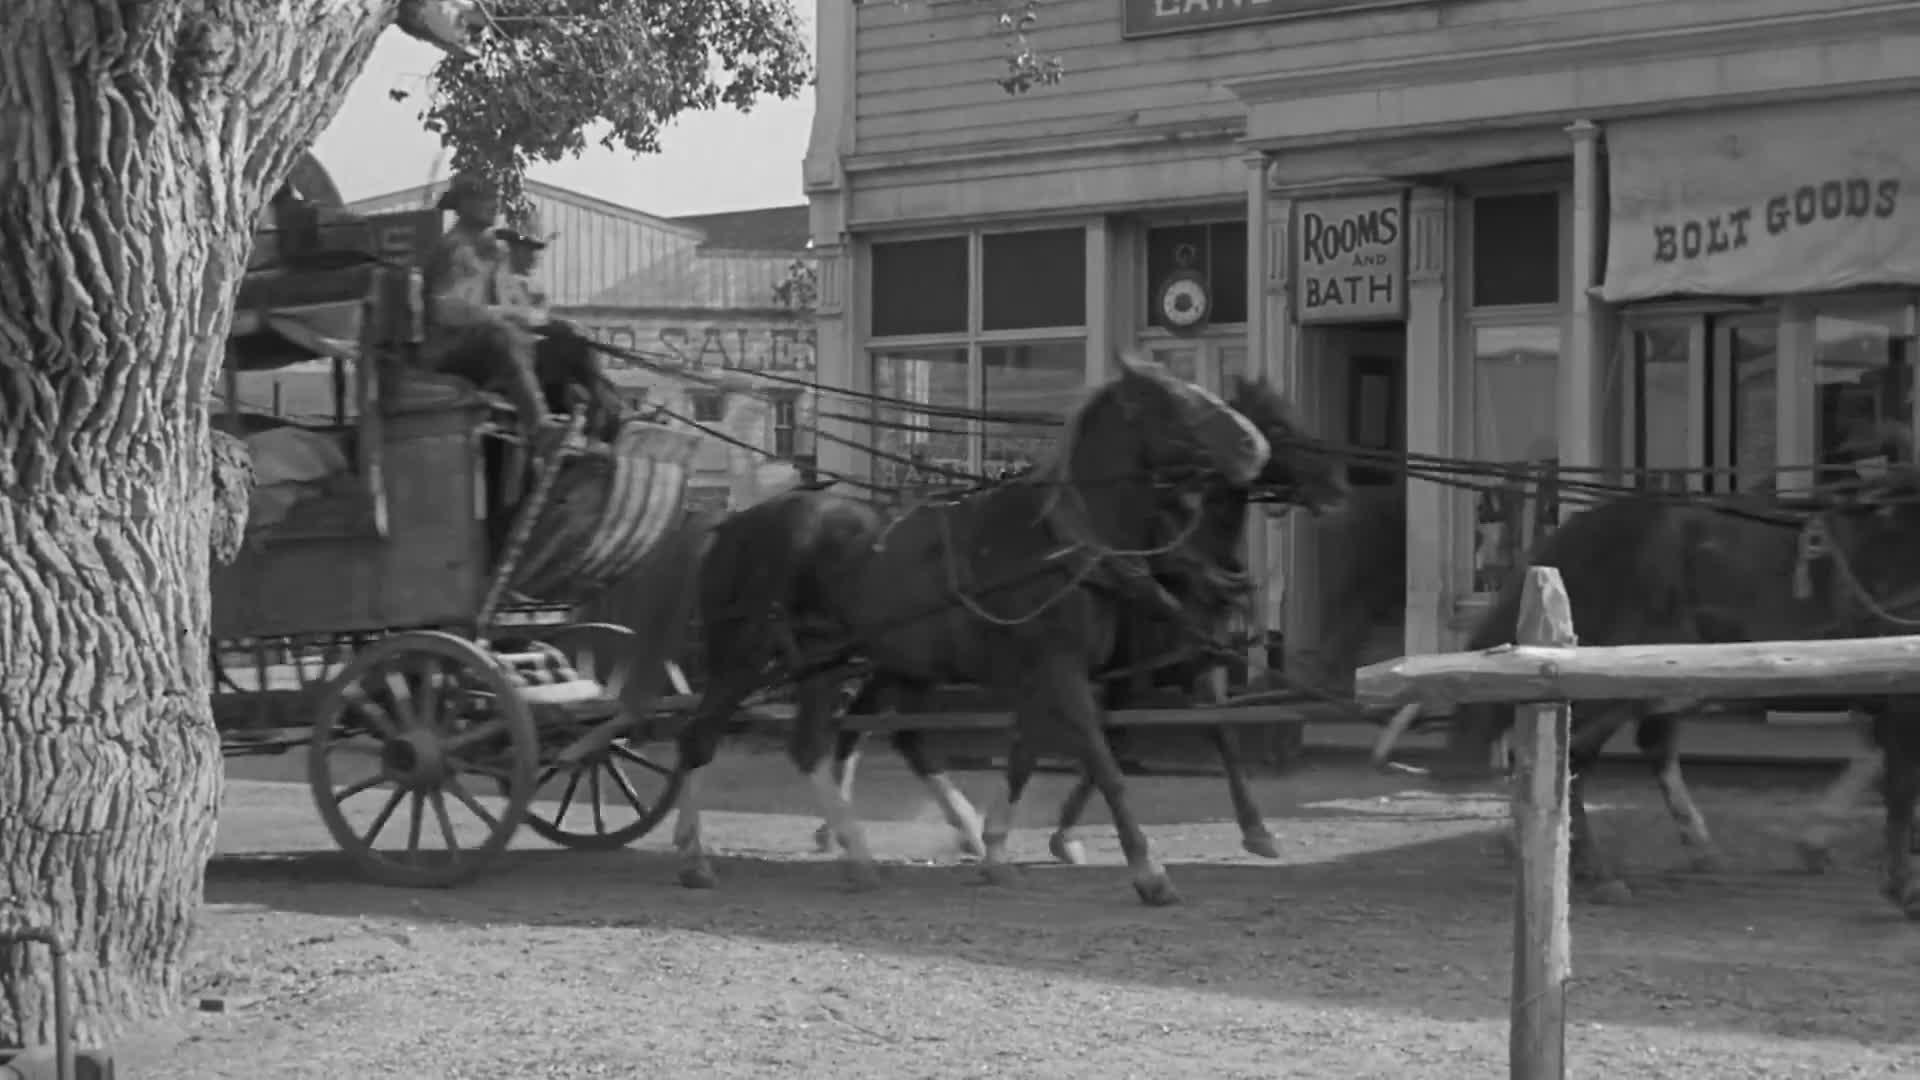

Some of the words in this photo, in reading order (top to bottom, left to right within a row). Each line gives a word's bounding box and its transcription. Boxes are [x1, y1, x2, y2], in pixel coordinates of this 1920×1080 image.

[1303, 207, 1398, 265] ROOMS
[1653, 205, 1751, 263] BOLT
[1765, 178, 1900, 237] GOODS
[1352, 252, 1387, 266] AND
[1305, 272, 1392, 308] BATH
